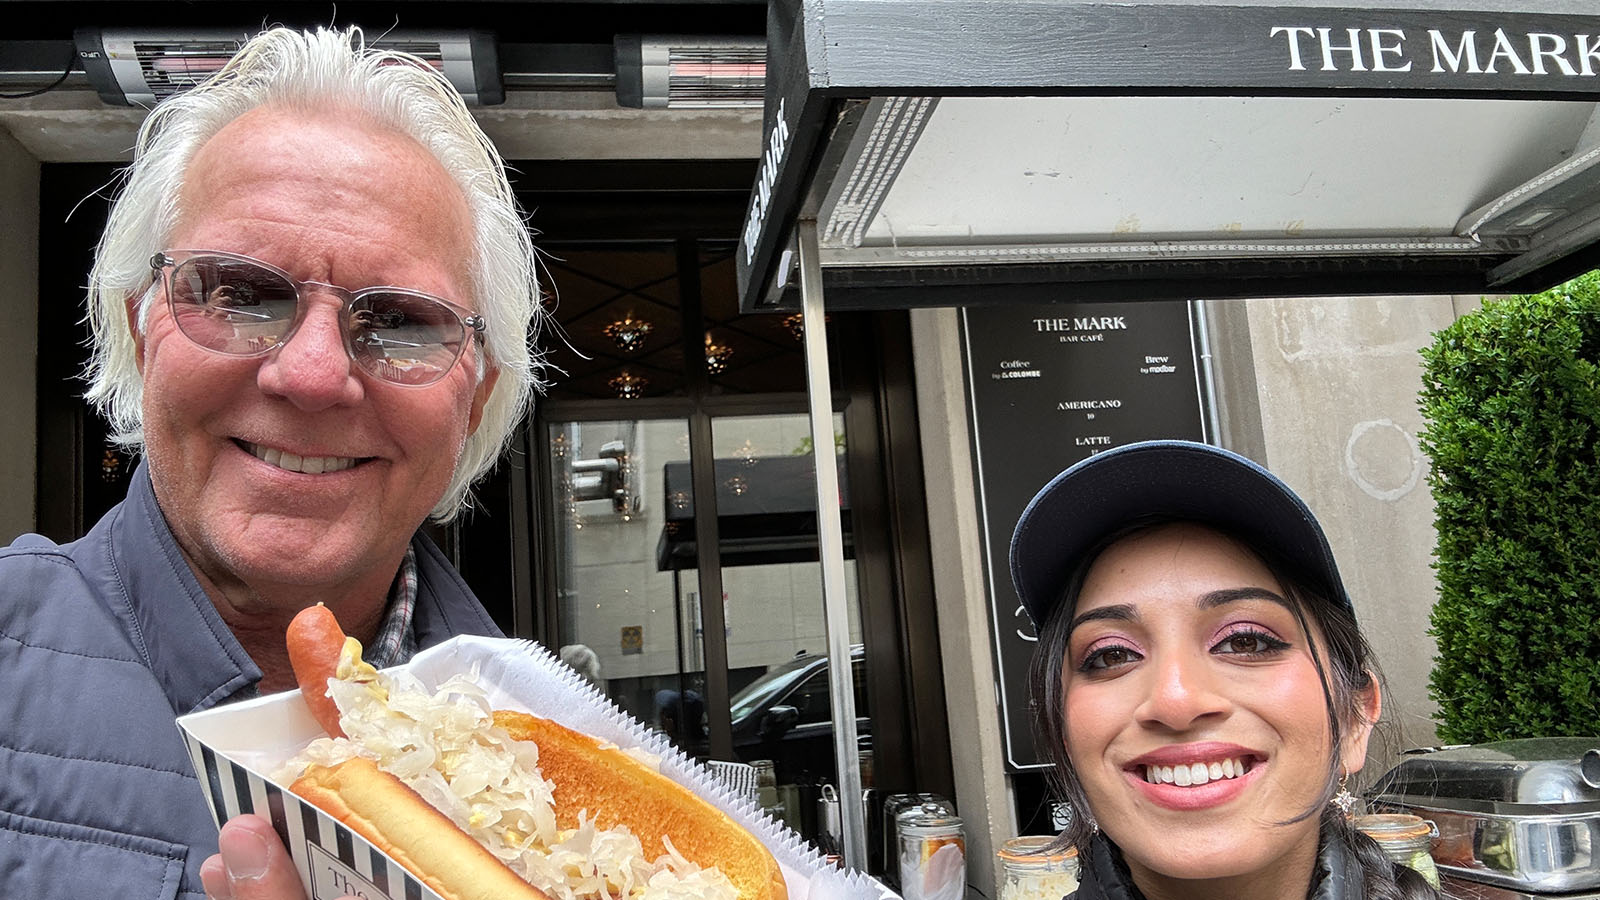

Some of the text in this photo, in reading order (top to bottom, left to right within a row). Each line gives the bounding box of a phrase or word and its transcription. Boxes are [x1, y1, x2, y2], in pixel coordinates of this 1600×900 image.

[1270, 26, 1600, 76] THE MARK
[758, 97, 789, 221] MARK
[1033, 316, 1127, 332] THE MARK
[1060, 335, 1078, 343] BAR
[1000, 359, 1030, 369] Coffee
[1145, 355, 1169, 364] Brew
[1057, 399, 1121, 410] AMERICANO
[1075, 436, 1111, 446] LATTE
